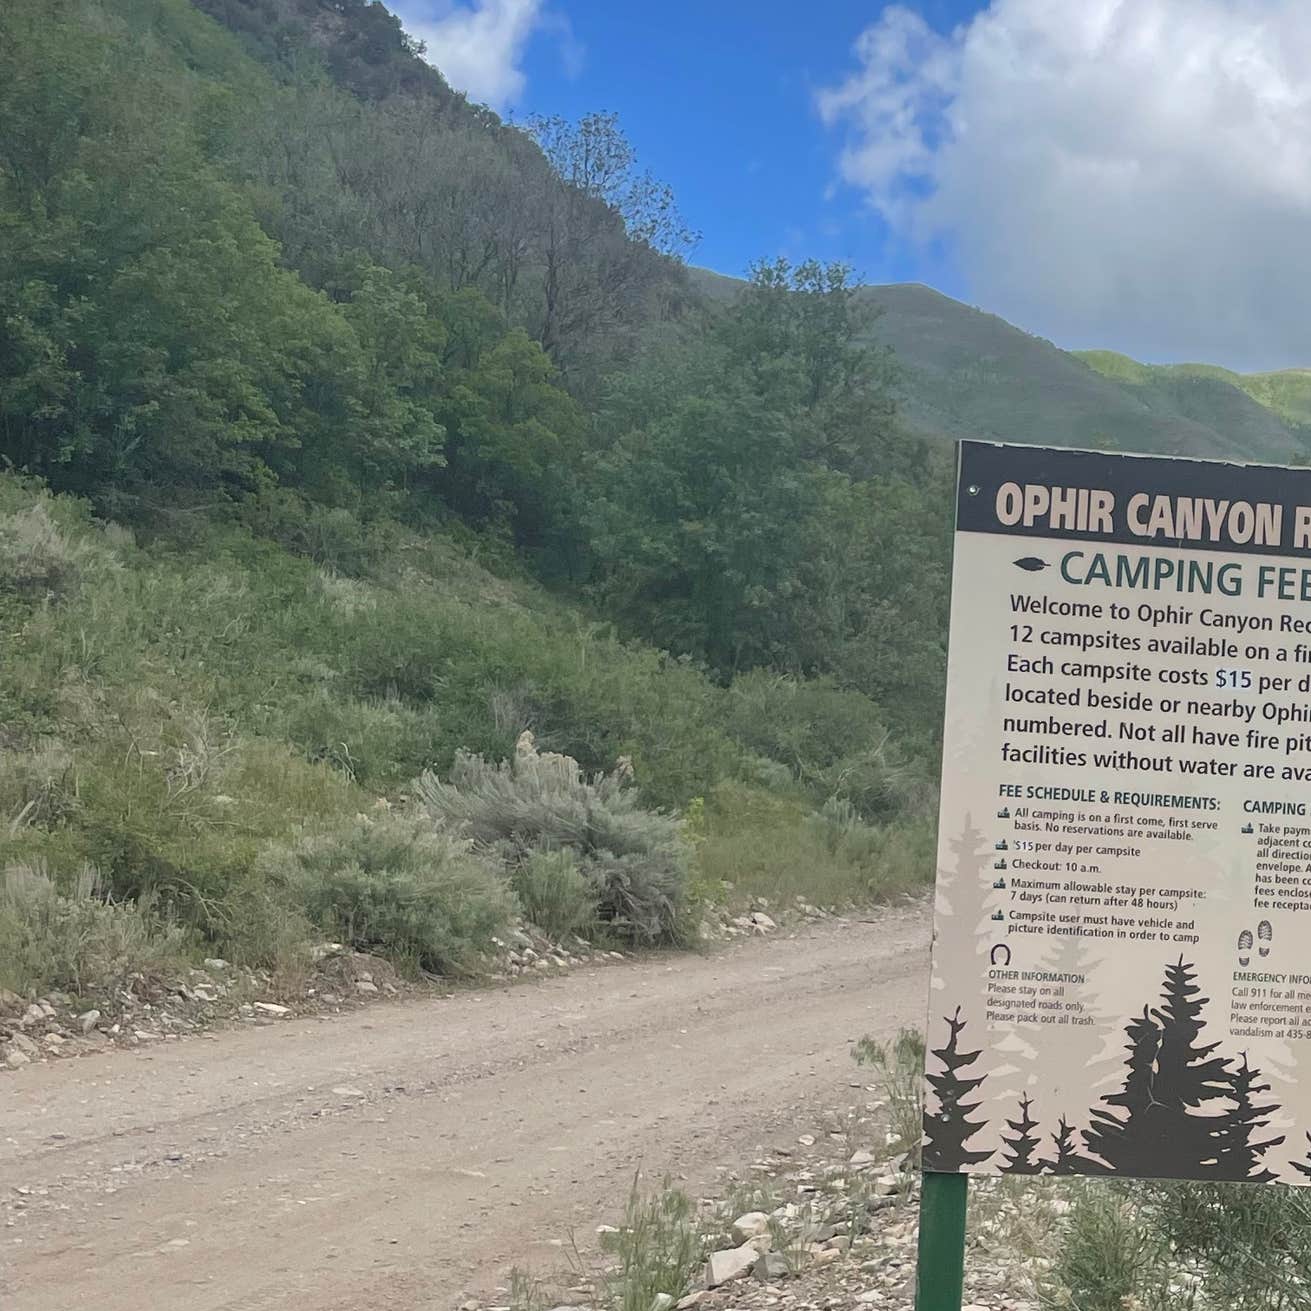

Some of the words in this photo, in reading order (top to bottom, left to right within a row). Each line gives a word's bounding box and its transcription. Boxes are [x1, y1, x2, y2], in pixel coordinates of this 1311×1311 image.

[996, 483, 1115, 533] OPHIR
[1127, 494, 1282, 546] CANYON
[1060, 552, 1242, 595] CAMPING
[1010, 595, 1102, 618] Welcome
[1109, 603, 1130, 620] to
[1138, 604, 1193, 627] Ophir
[1200, 609, 1272, 633] Canyon
[1010, 625, 1032, 643] 12
[1040, 631, 1141, 651] campsites
[1148, 637, 1238, 657] available
[1245, 646, 1269, 660] on
[1276, 648, 1287, 661] a
[1008, 654, 1053, 674] Each
[1061, 662, 1151, 682] campsite
[1158, 669, 1208, 685] costs
[1216, 669, 1251, 688] $15
[1259, 677, 1291, 694] per
[1006, 683, 1080, 706] located
[1088, 689, 1152, 711] beside
[1160, 699, 1180, 713] or
[1187, 699, 1256, 723] nearby
[1004, 716, 1112, 738] numbered.
[1119, 722, 1155, 741] Not
[1162, 724, 1185, 743] all
[1192, 726, 1239, 747] have
[1246, 729, 1279, 749] fire
[1001, 743, 1086, 766] facilities
[1093, 751, 1172, 772] without
[1178, 759, 1237, 776] water
[1243, 764, 1274, 779] are
[999, 784, 1022, 797] FEE
[1027, 786, 1095, 802] SCHEDULE
[1100, 790, 1109, 803] &
[1243, 800, 1305, 815] CAMPING
[1015, 807, 1028, 817] All
[1032, 811, 1074, 823] camping
[1078, 813, 1086, 821] is
[1089, 814, 1101, 822] on
[1104, 815, 1110, 823] a
[1113, 813, 1133, 824] first
[1169, 816, 1188, 828] first
[1191, 821, 1218, 830] serve
[1045, 822, 1059, 832] No
[1062, 825, 1124, 836] reservations
[1127, 829, 1143, 837] are
[1259, 823, 1280, 834] Take
[1035, 842, 1052, 853] per
[1055, 842, 1073, 855] day
[1076, 845, 1092, 855] per
[1096, 847, 1140, 857] campsite
[1257, 837, 1299, 850] adjacent
[1257, 849, 1269, 857] all
[1066, 862, 1077, 872] 10
[1255, 873, 1272, 884] has
[1275, 874, 1299, 884] been
[1011, 878, 1060, 891] Maximum
[1063, 881, 1112, 893] allowable
[1115, 885, 1136, 897] stay
[1139, 888, 1155, 897] per
[1011, 890, 1016, 900] 7
[1019, 891, 1042, 904] days
[1046, 893, 1066, 903] (can
[1070, 896, 1100, 904] return
[1104, 896, 1128, 906] after
[1131, 898, 1143, 908] 48
[1146, 898, 1177, 911] hours)
[1254, 898, 1269, 908] fee
[1009, 910, 1056, 923] Campsite
[1059, 915, 1080, 923] user
[1083, 916, 1108, 925] must
[1111, 915, 1135, 926] have
[1138, 918, 1173, 928] vehicle
[1176, 920, 1194, 929] and
[988, 969, 1018, 980] OTHER
[1021, 972, 1084, 983] INFORMATION
[1233, 971, 1287, 983] EMERGENCY
[1232, 987, 1248, 996] Call
[1251, 987, 1266, 997] 911
[1270, 988, 1282, 998] for
[1284, 990, 1295, 999] all
[1229, 1027, 1273, 1037] vandalism
